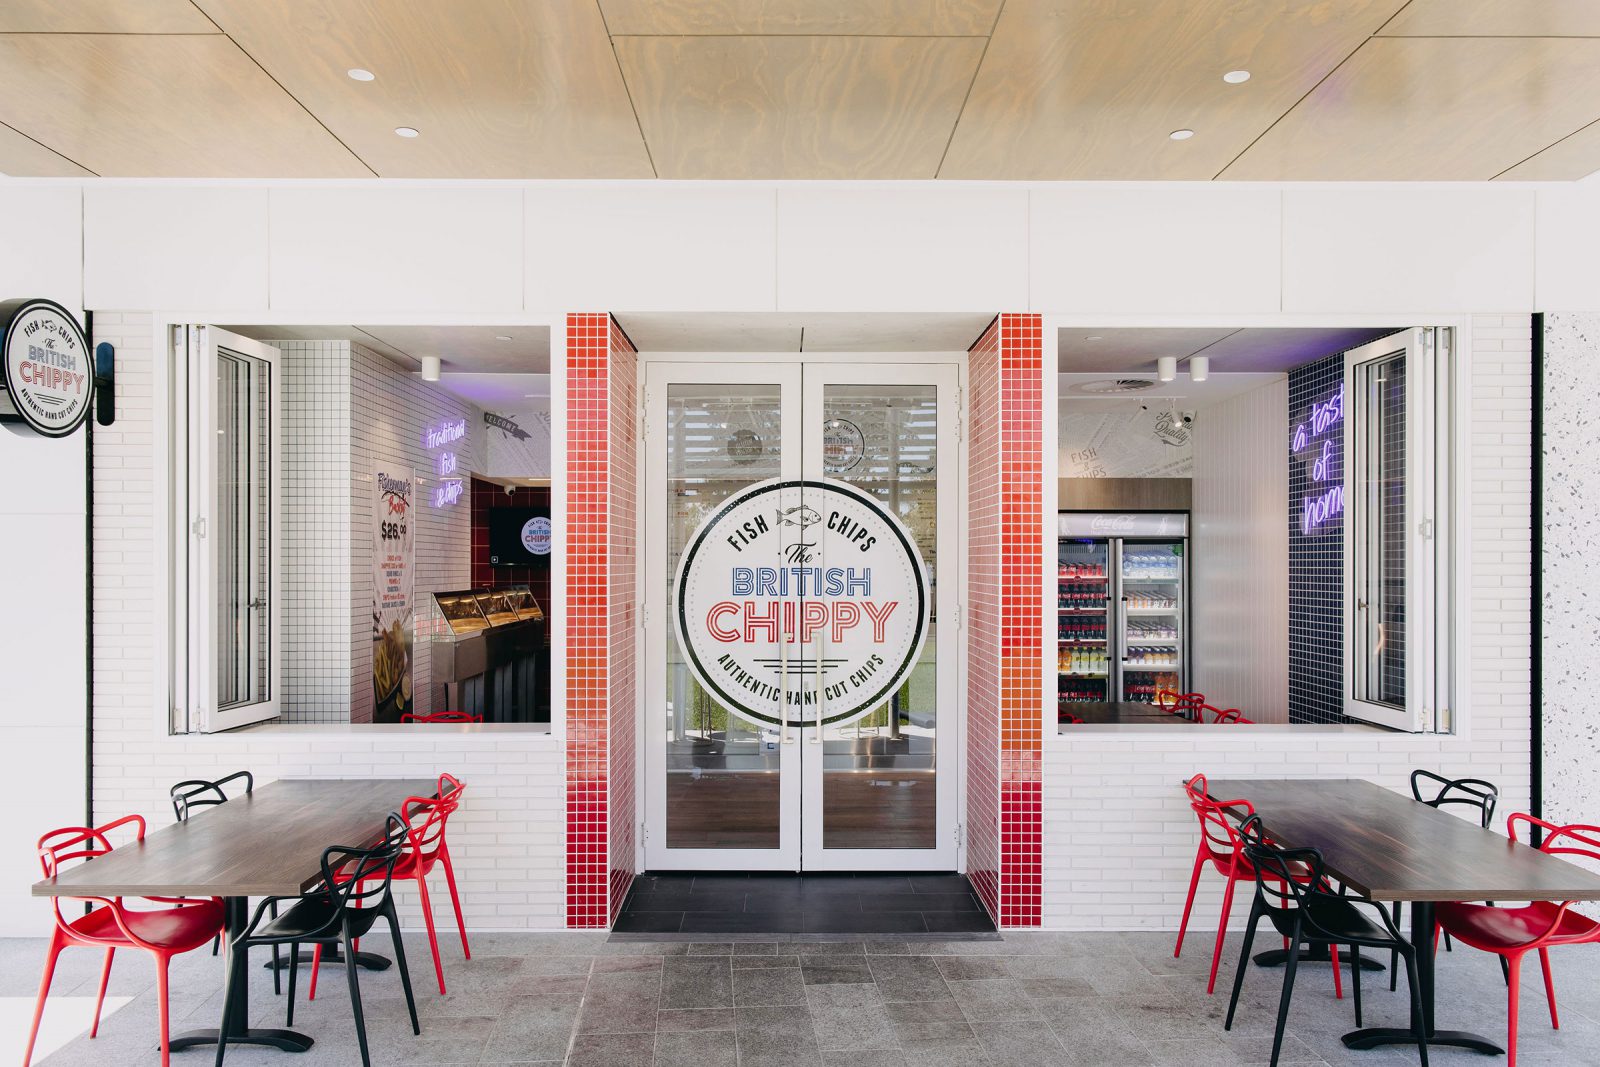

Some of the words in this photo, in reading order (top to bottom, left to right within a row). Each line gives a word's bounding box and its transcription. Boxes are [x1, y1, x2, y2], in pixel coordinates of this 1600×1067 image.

[24, 320, 40, 338] FISH
[58, 326, 76, 350] CHIPS
[44, 337, 56, 350] The
[28, 344, 76, 371] BRITISH
[19, 360, 85, 395] CHIPPY
[21, 388, 44, 417] AUTHENTIC
[45, 411, 58, 420] HAND
[58, 409, 67, 419] CUT
[66, 398, 79, 415] CHIPS
[1293, 424, 1306, 452] a
[1310, 383, 1344, 436] tast
[427, 419, 465, 448] traditional
[486, 414, 516, 432] ELCOME
[1155, 420, 1188, 444] Quality
[441, 453, 456, 476] fish
[1070, 447, 1097, 463] FISH
[1313, 440, 1332, 481] of
[445, 481, 463, 504] chips
[524, 535, 551, 543] CHIPP
[727, 513, 770, 552] FISH
[827, 511, 877, 552] CHIPS
[784, 542, 817, 564] The
[732, 567, 871, 597] BRITISH
[706, 601, 899, 643] CHIPPY
[717, 653, 781, 702] AUTHENTIC
[824, 680, 848, 701] CUT
[849, 653, 885, 688] CHIPS
